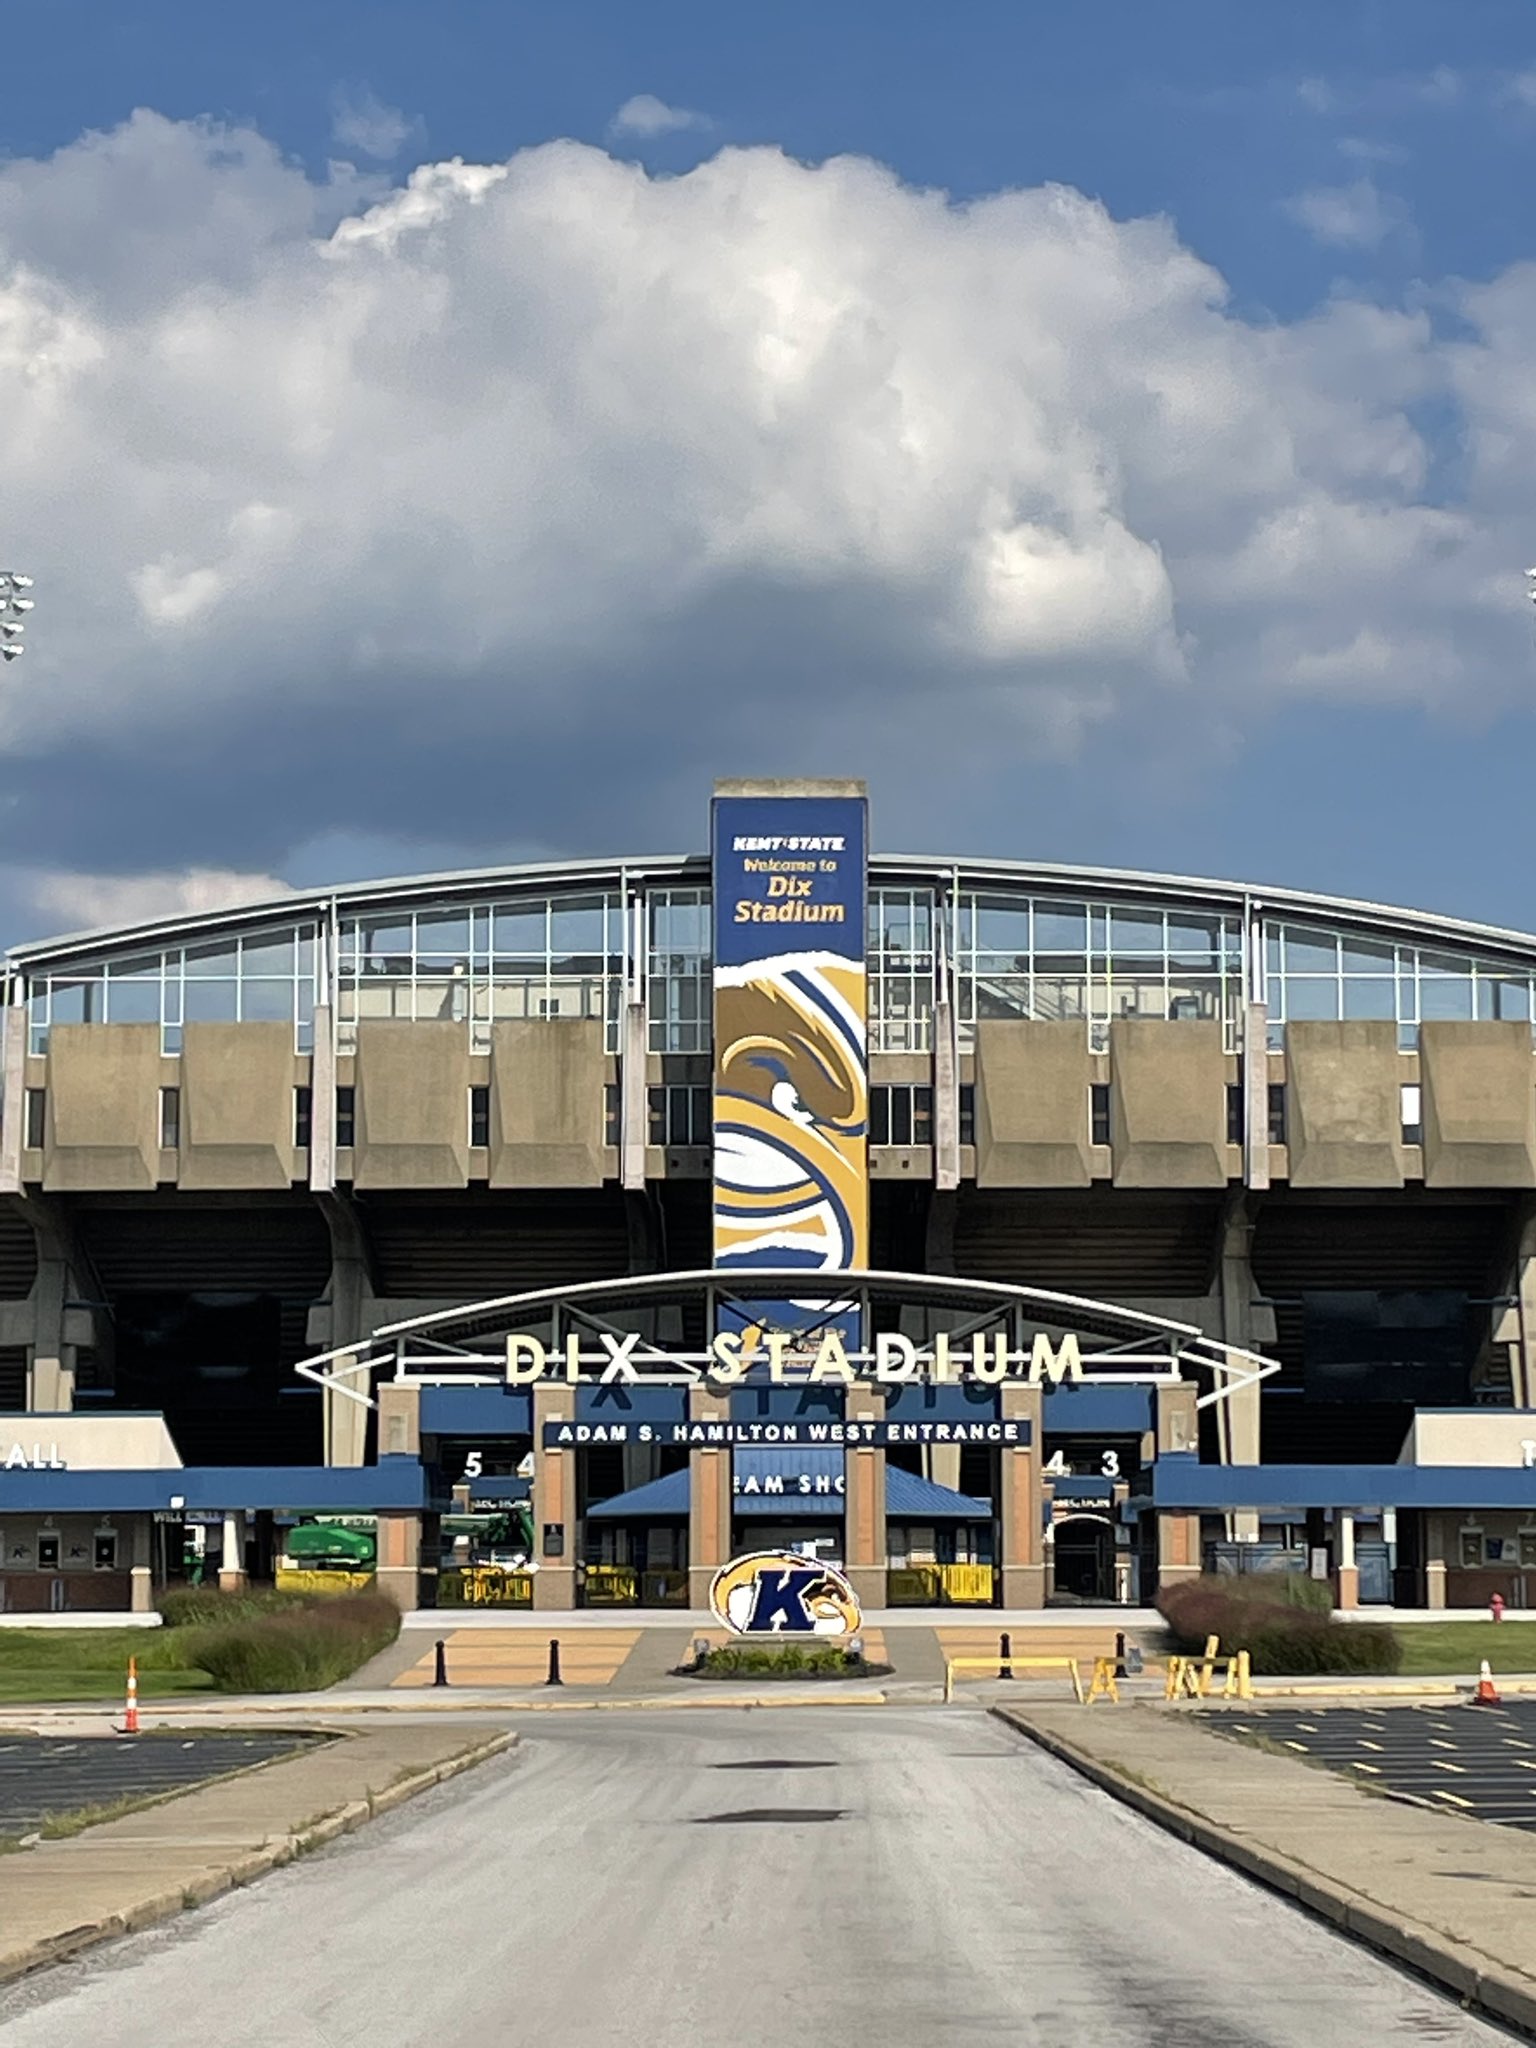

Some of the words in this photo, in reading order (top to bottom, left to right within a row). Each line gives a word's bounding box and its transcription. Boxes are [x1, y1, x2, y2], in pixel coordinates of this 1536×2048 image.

[733, 837, 783, 851] KENT
[787, 837, 846, 851] STATE
[744, 858, 816, 872] Welcome
[819, 858, 837, 872] to
[767, 876, 813, 897] Dix
[733, 901, 844, 923] Stadium
[506, 1333, 640, 1383] DIX
[709, 1331, 1083, 1383] STADIUM
[558, 1425, 627, 1441] ADAM
[639, 1425, 662, 1440] S.
[674, 1424, 798, 1441] HAMILTON
[809, 1424, 876, 1440] WEST
[887, 1424, 1018, 1440] ENTRANCE
[464, 1452, 482, 1478] 5
[516, 1451, 535, 1477] 4
[1044, 1450, 1068, 1476] 4
[1101, 1450, 1119, 1477] 3
[746, 1570, 827, 1631] K
